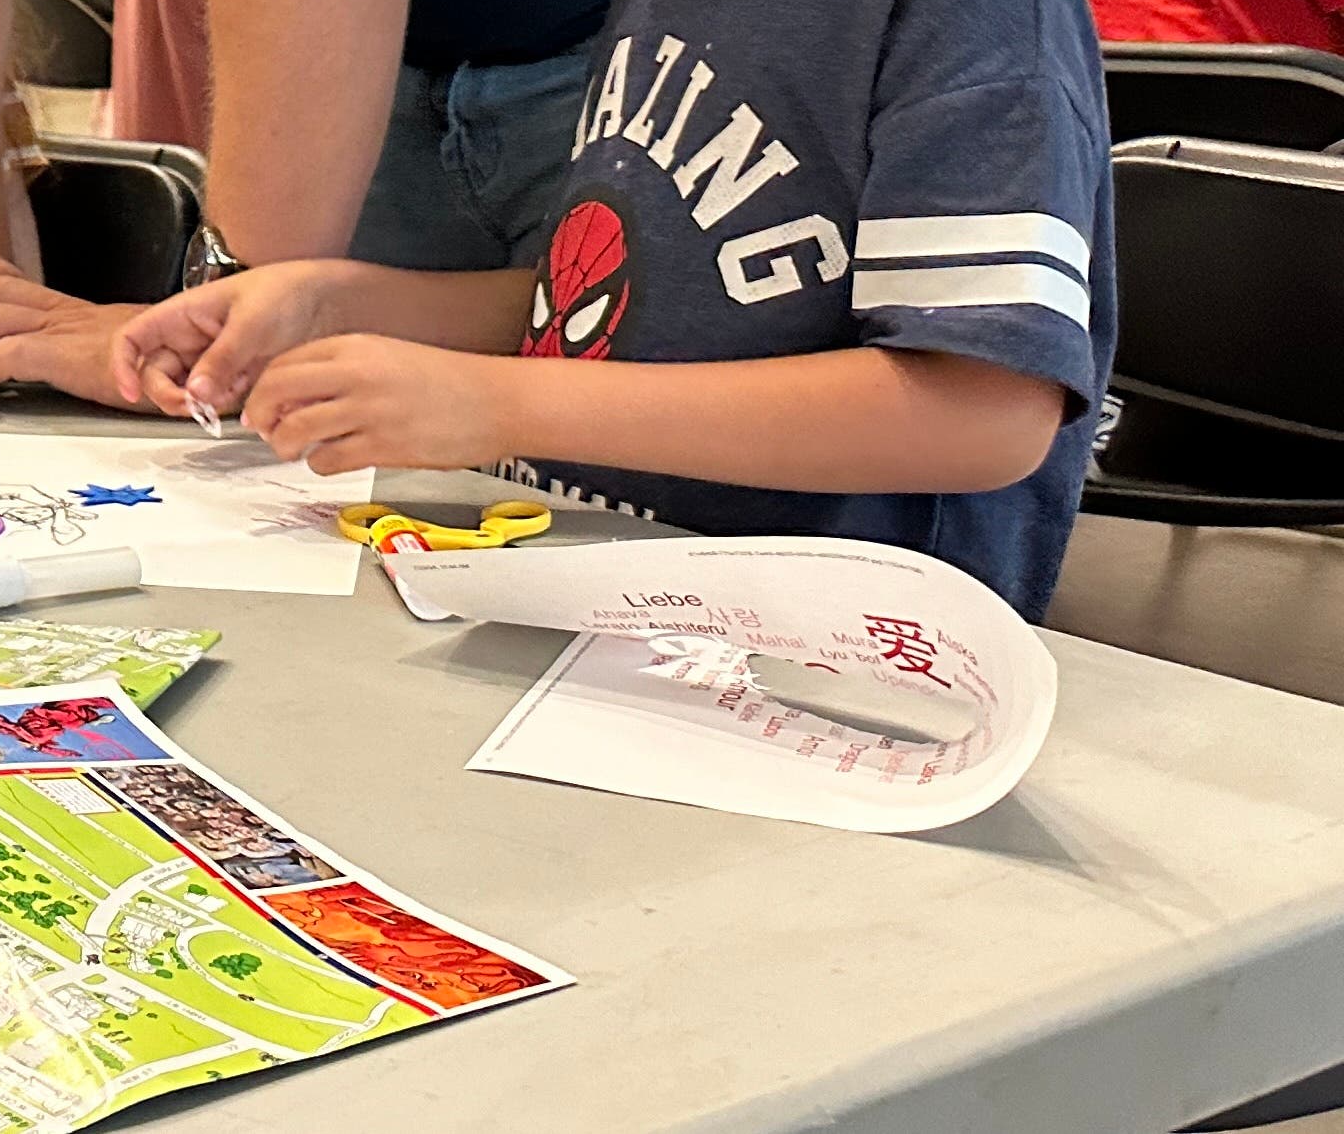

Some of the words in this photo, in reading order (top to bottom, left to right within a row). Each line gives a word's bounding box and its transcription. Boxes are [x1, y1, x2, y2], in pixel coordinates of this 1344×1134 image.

[571, 34, 850, 306] AZING
[622, 591, 703, 609] Liebe
[593, 609, 651, 620] Ahava
[706, 607, 763, 628] 사랑
[745, 633, 808, 649] Mahal
[831, 632, 879, 649] Mura
[862, 613, 952, 689] 爱
